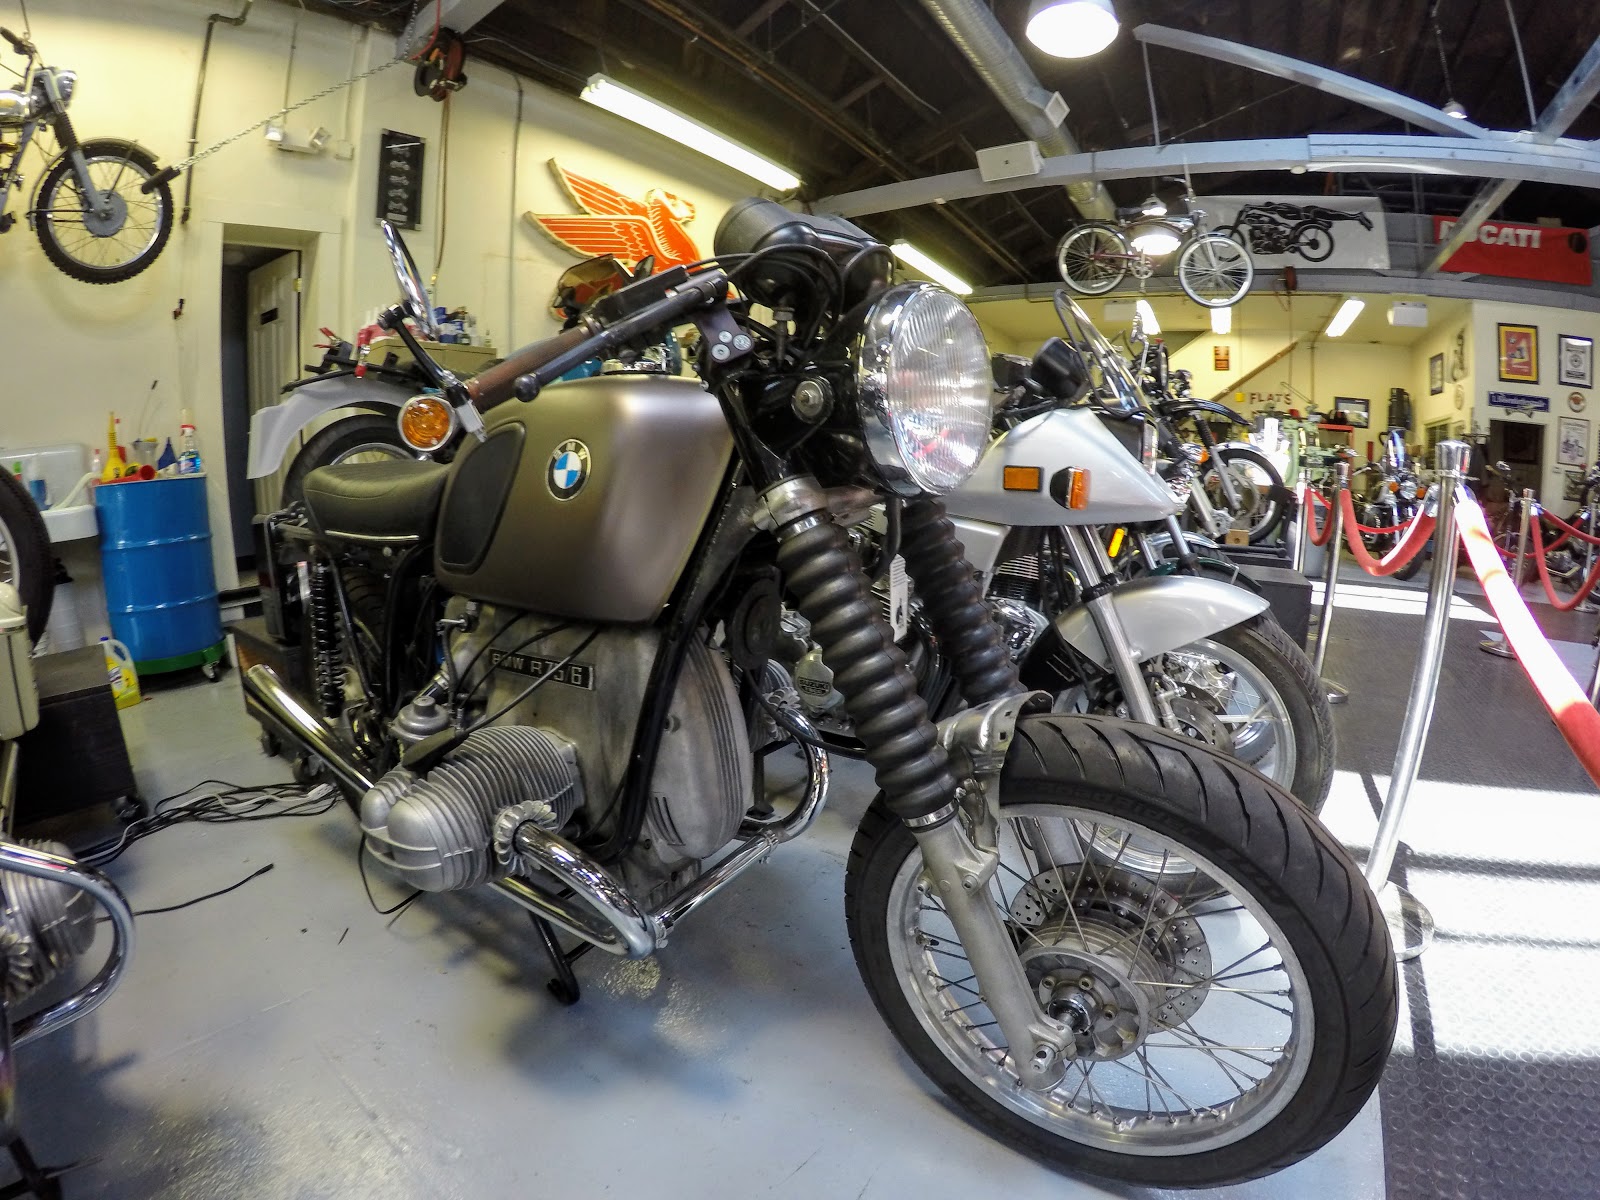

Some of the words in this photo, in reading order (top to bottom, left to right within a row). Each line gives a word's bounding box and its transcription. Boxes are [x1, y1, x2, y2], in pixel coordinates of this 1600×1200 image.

[1438, 220, 1542, 249] DCATI
[1250, 392, 1292, 405] FLATS
[552, 441, 588, 460] BMW
[798, 678, 830, 690] SUZUKI
